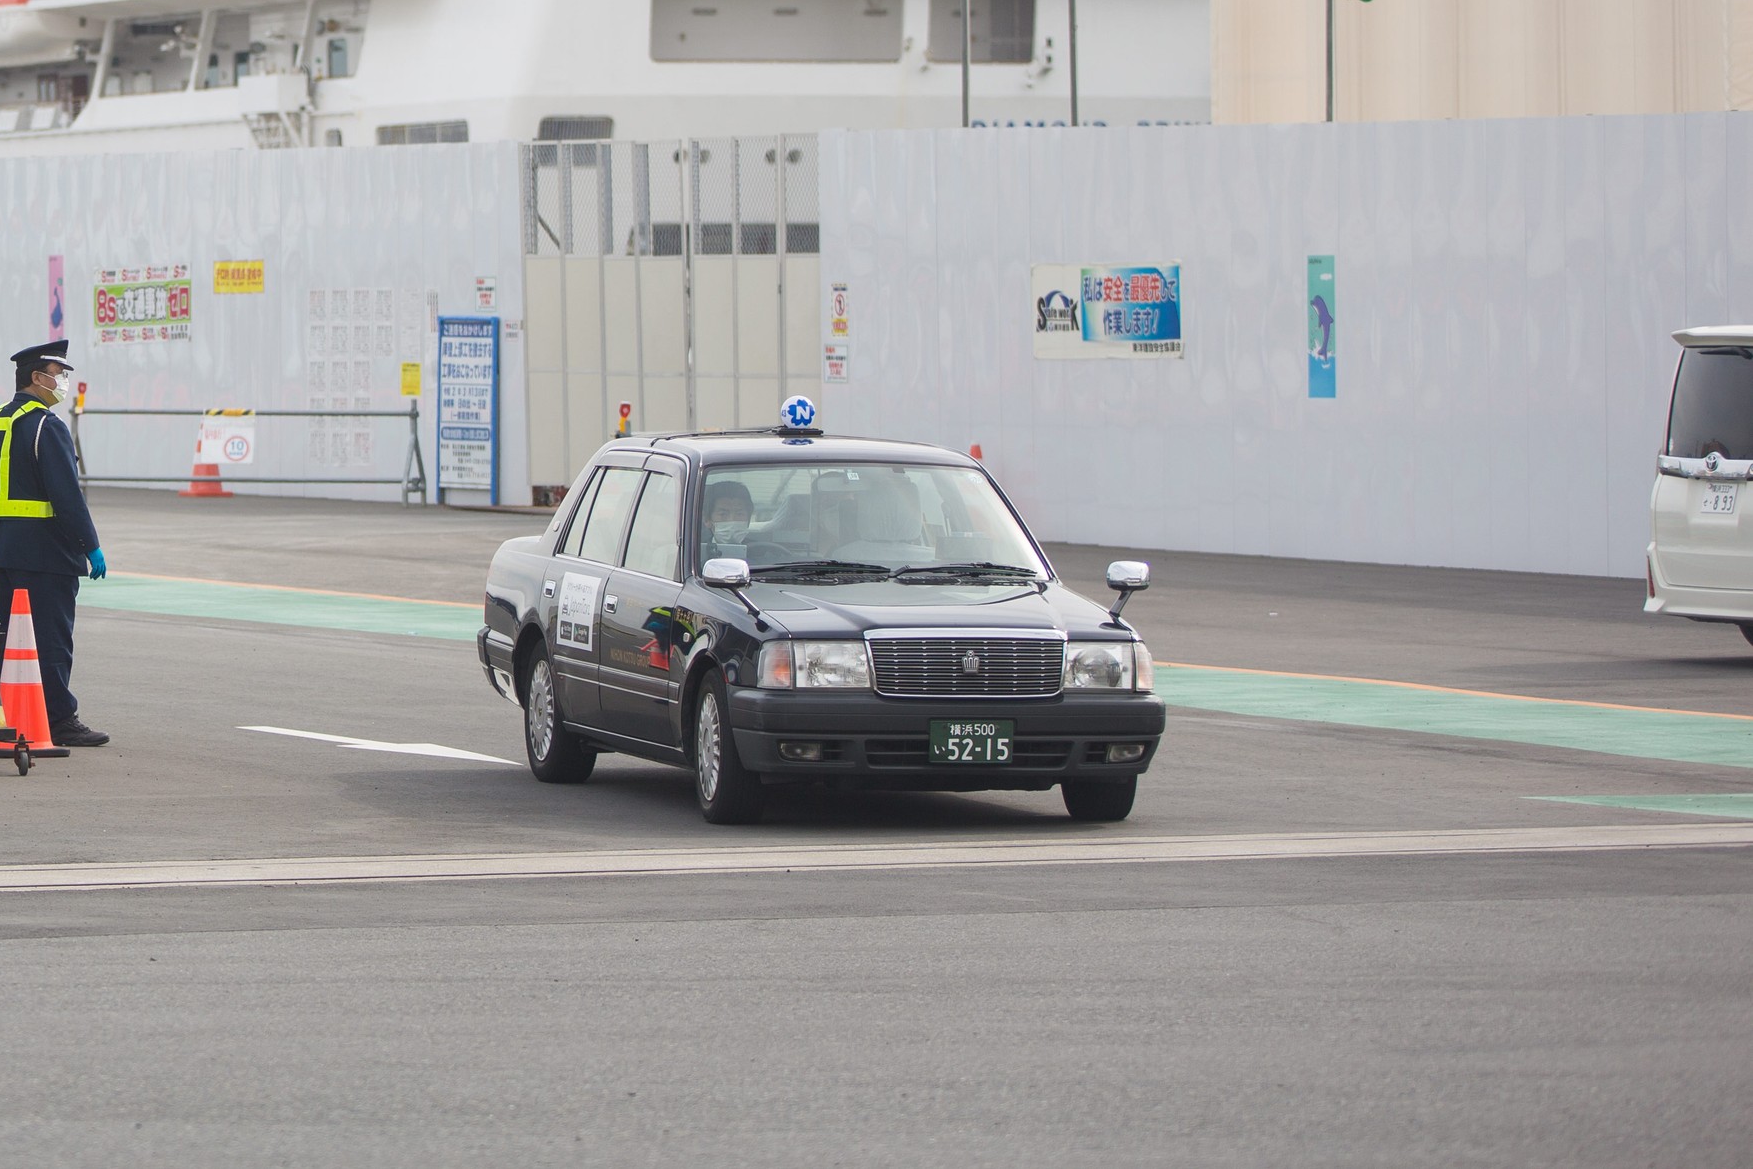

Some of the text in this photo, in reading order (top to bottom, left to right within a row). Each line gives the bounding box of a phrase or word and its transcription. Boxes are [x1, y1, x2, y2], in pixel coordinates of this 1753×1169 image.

[1083, 273, 1177, 303] 私は安全を最優先して
[796, 405, 810, 420] N
[231, 440, 244, 452] 10
[949, 723, 995, 736] 横浜500
[933, 738, 1009, 761] い 52-15
